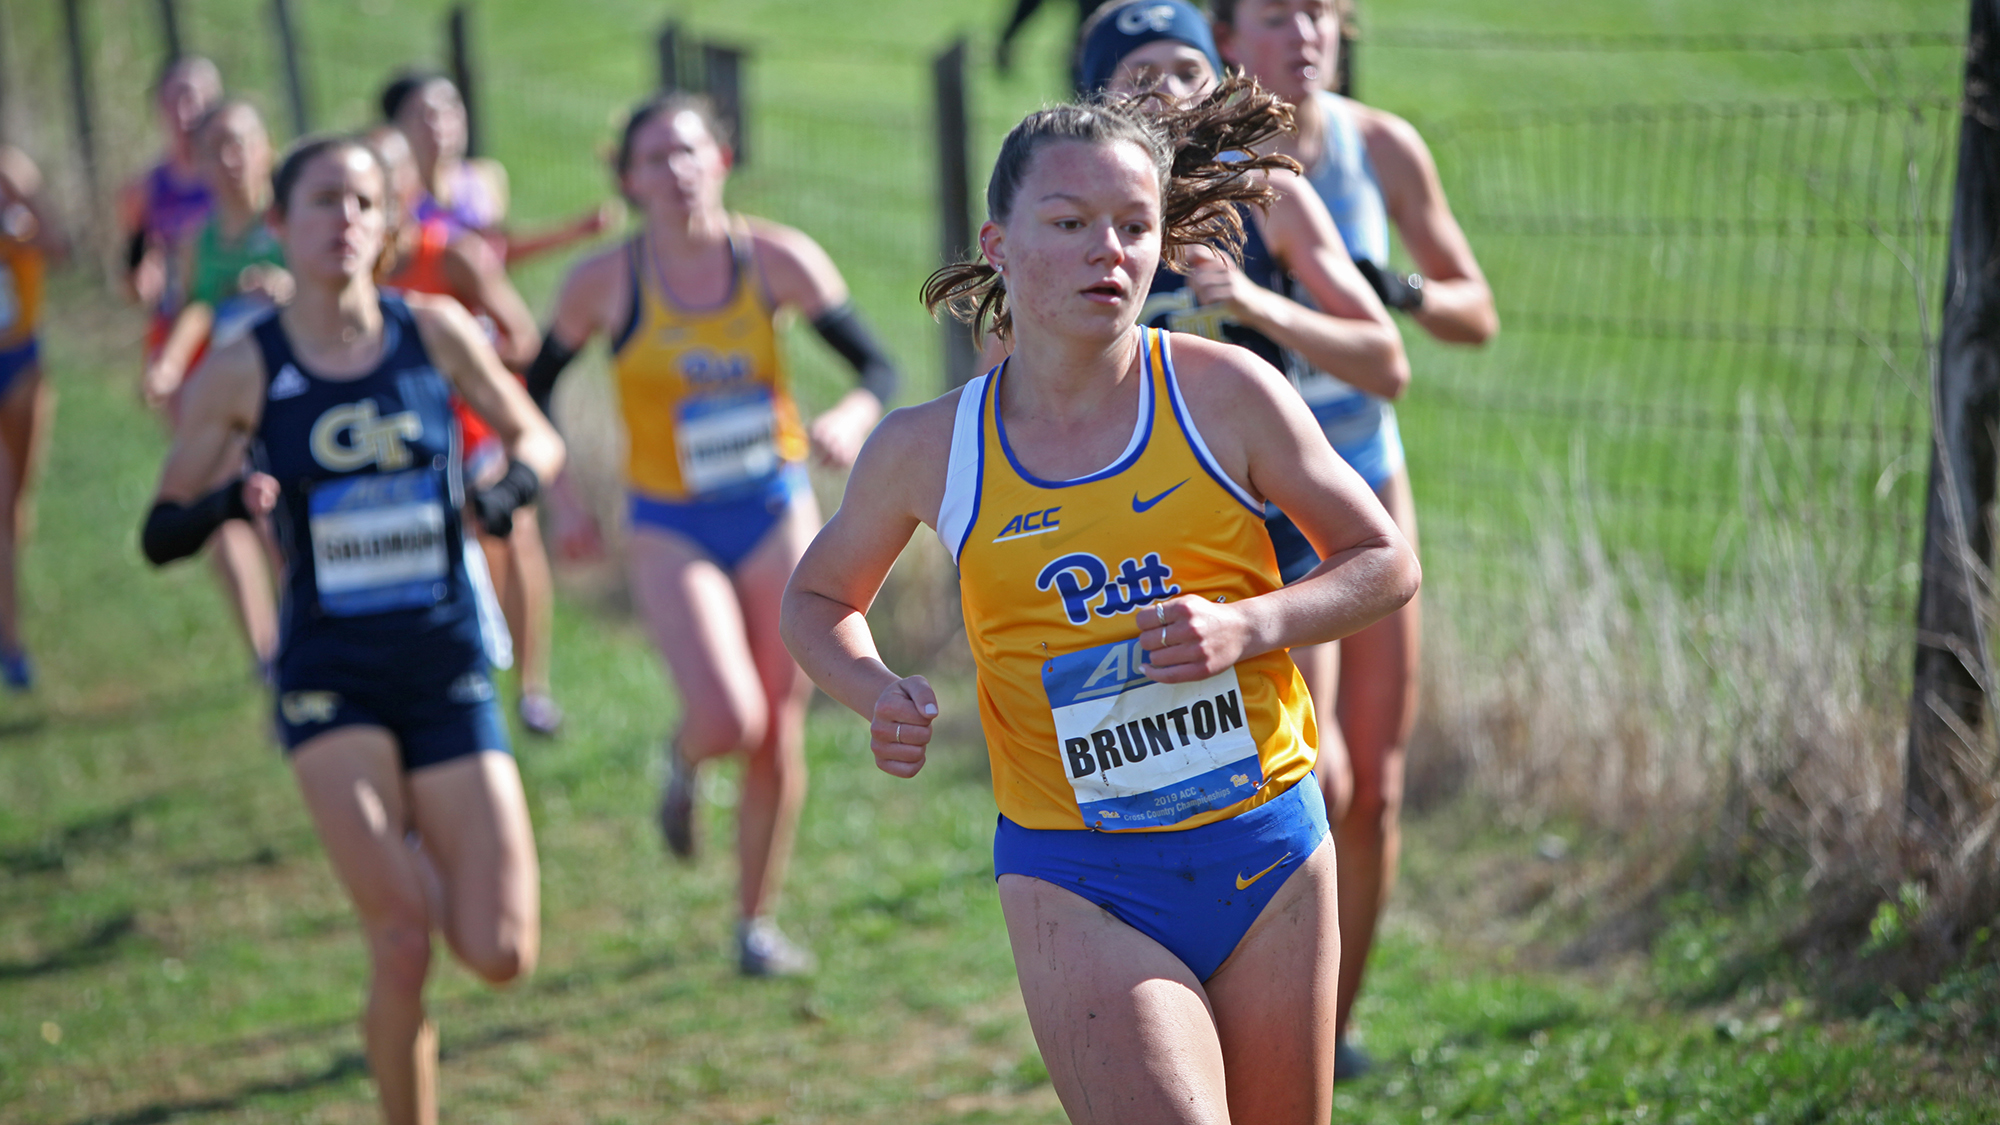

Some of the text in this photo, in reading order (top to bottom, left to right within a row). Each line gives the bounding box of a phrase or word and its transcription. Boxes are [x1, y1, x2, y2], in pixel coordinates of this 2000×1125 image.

[997, 506, 1063, 537] ACC
[1036, 552, 1181, 625] Pitt
[1065, 689, 1243, 779] BRUNTON
[1146, 805, 1175, 819] Country
[1175, 787, 1231, 812] Championships
[1154, 786, 1197, 807] 2019 ACC
